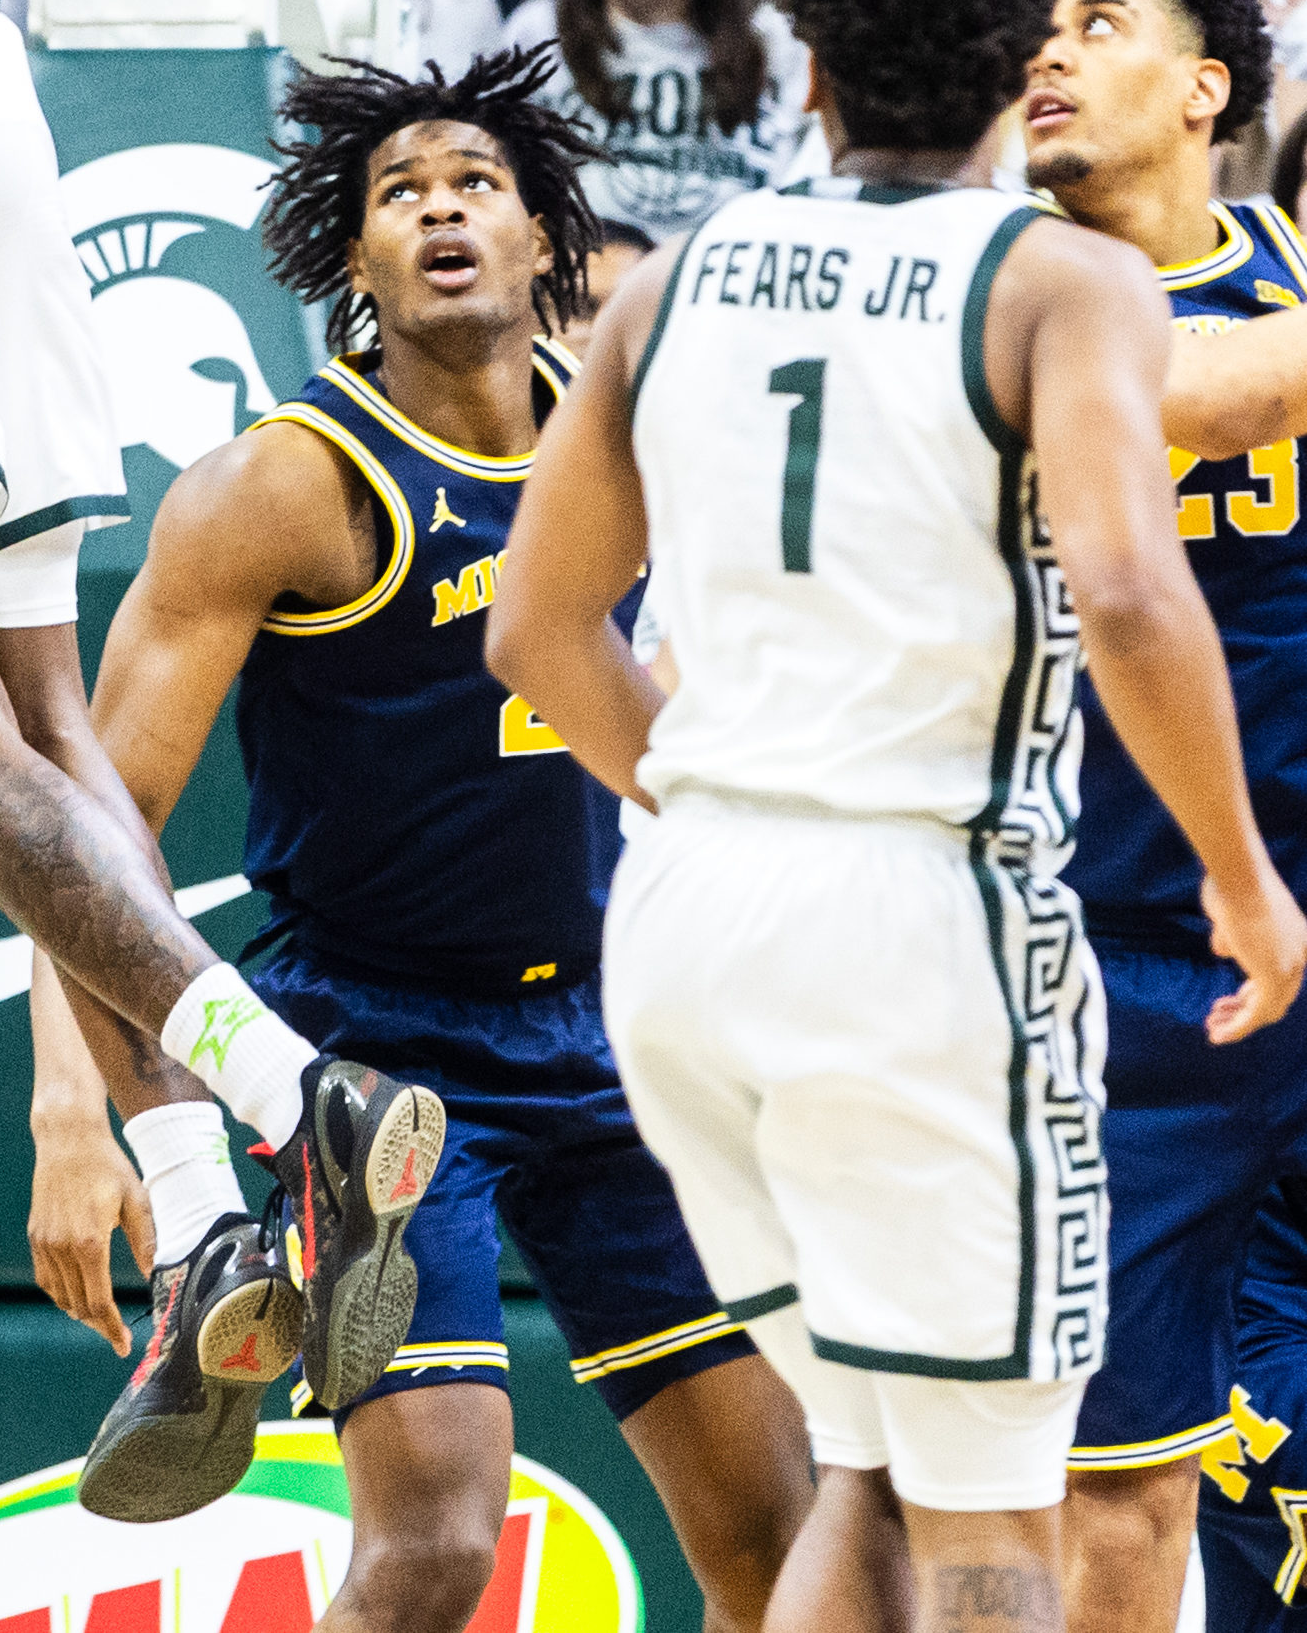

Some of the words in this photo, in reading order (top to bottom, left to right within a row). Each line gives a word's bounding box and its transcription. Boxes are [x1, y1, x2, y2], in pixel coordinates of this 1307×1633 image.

[691, 241, 851, 312] FEARS
[863, 255, 945, 323] JR.
[768, 357, 829, 575] 1
